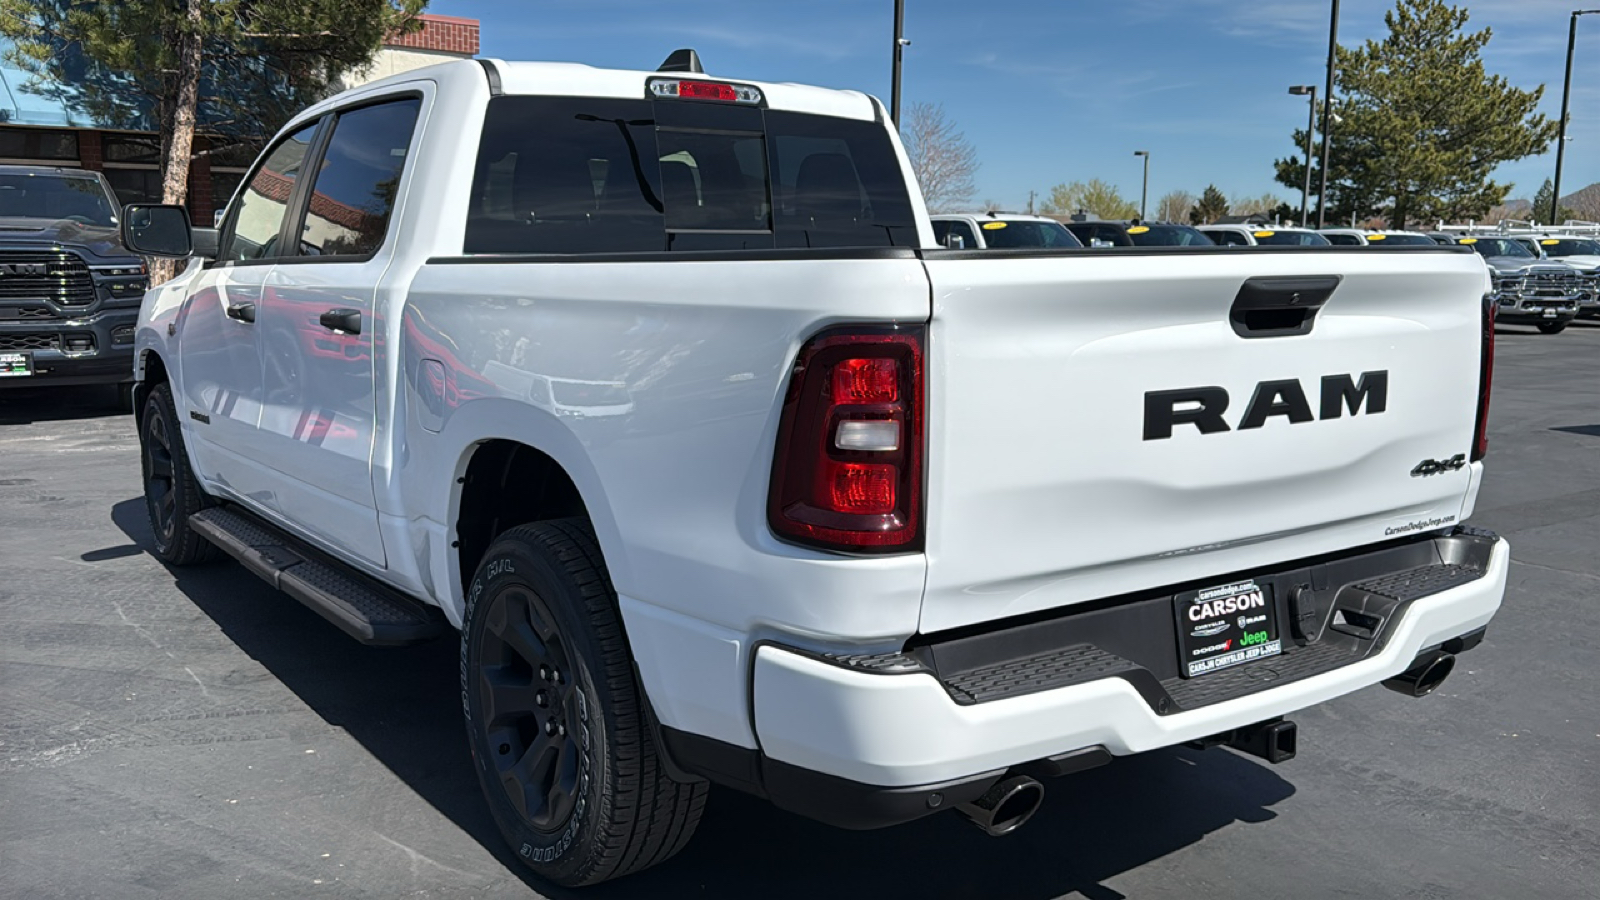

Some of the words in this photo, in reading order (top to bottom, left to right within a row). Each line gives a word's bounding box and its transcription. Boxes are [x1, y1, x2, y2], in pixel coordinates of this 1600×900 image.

[1143, 369, 1388, 441] RAM
[1410, 453, 1465, 477] 4x4
[1385, 515, 1455, 536] CarsonDodgeJeep.com
[487, 559, 515, 580] H/L
[1200, 582, 1253, 600] carsondodge.com
[1188, 591, 1265, 621] CARSON
[1246, 614, 1267, 624] RAM
[1239, 631, 1267, 646] Jeep
[1192, 642, 1226, 656] DODGE
[1215, 651, 1245, 667] CHRYSLER
[1245, 648, 1260, 660] JEEP
